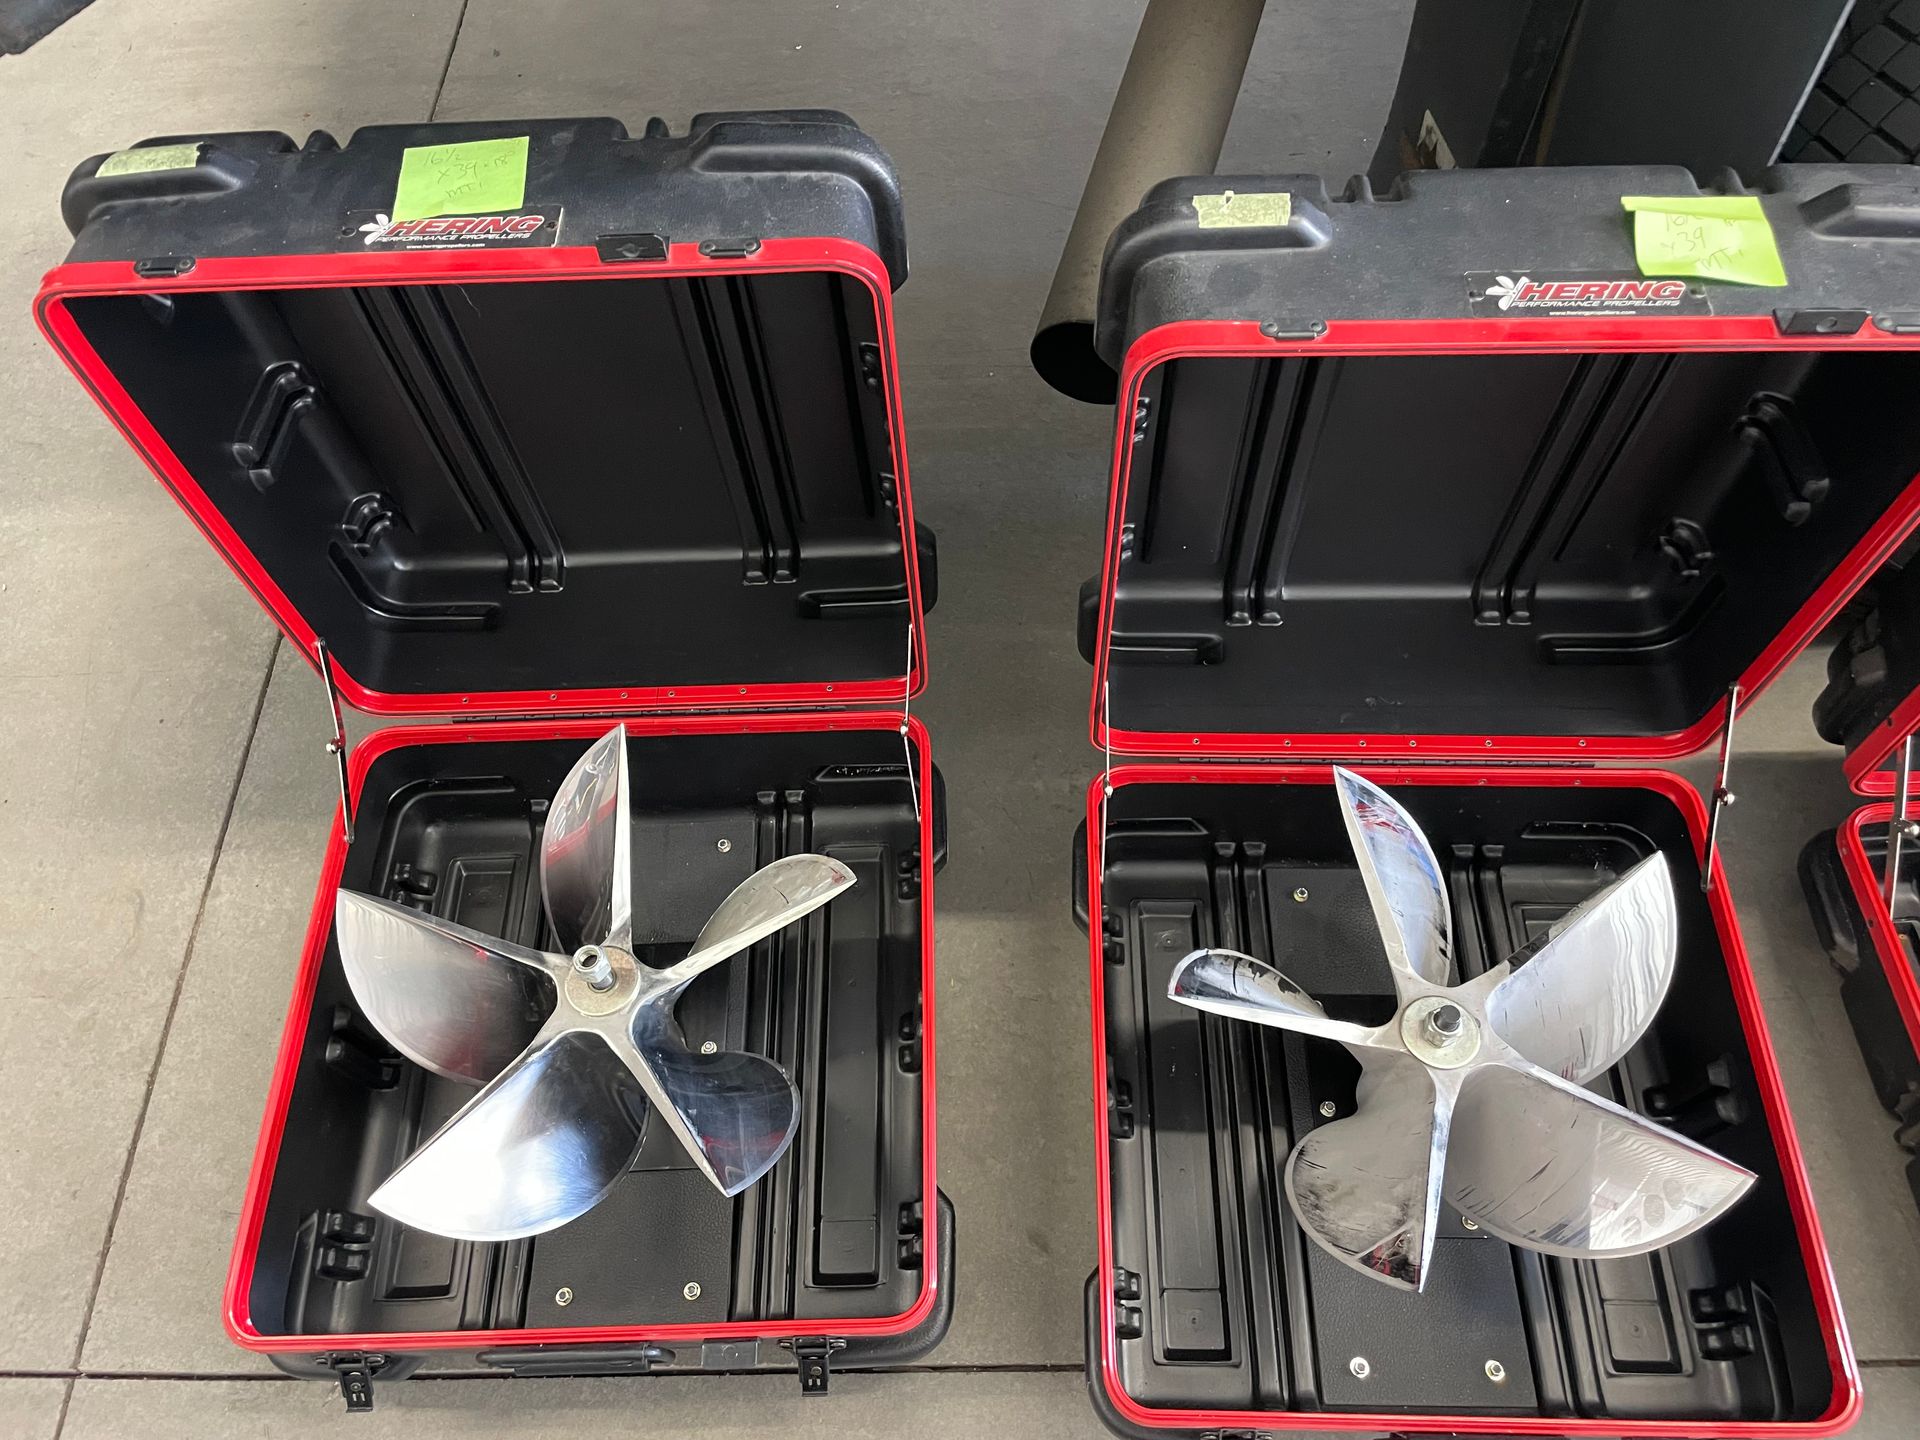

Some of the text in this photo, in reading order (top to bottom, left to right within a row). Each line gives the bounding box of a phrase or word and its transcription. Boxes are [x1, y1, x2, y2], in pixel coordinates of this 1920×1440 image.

[384, 215, 545, 236] HERING
[375, 232, 531, 243] PERFORMANCE PROPELLERS
[1517, 281, 1686, 300] HERING
[1512, 299, 1681, 308] PERFORMANCE PROPELLERS
